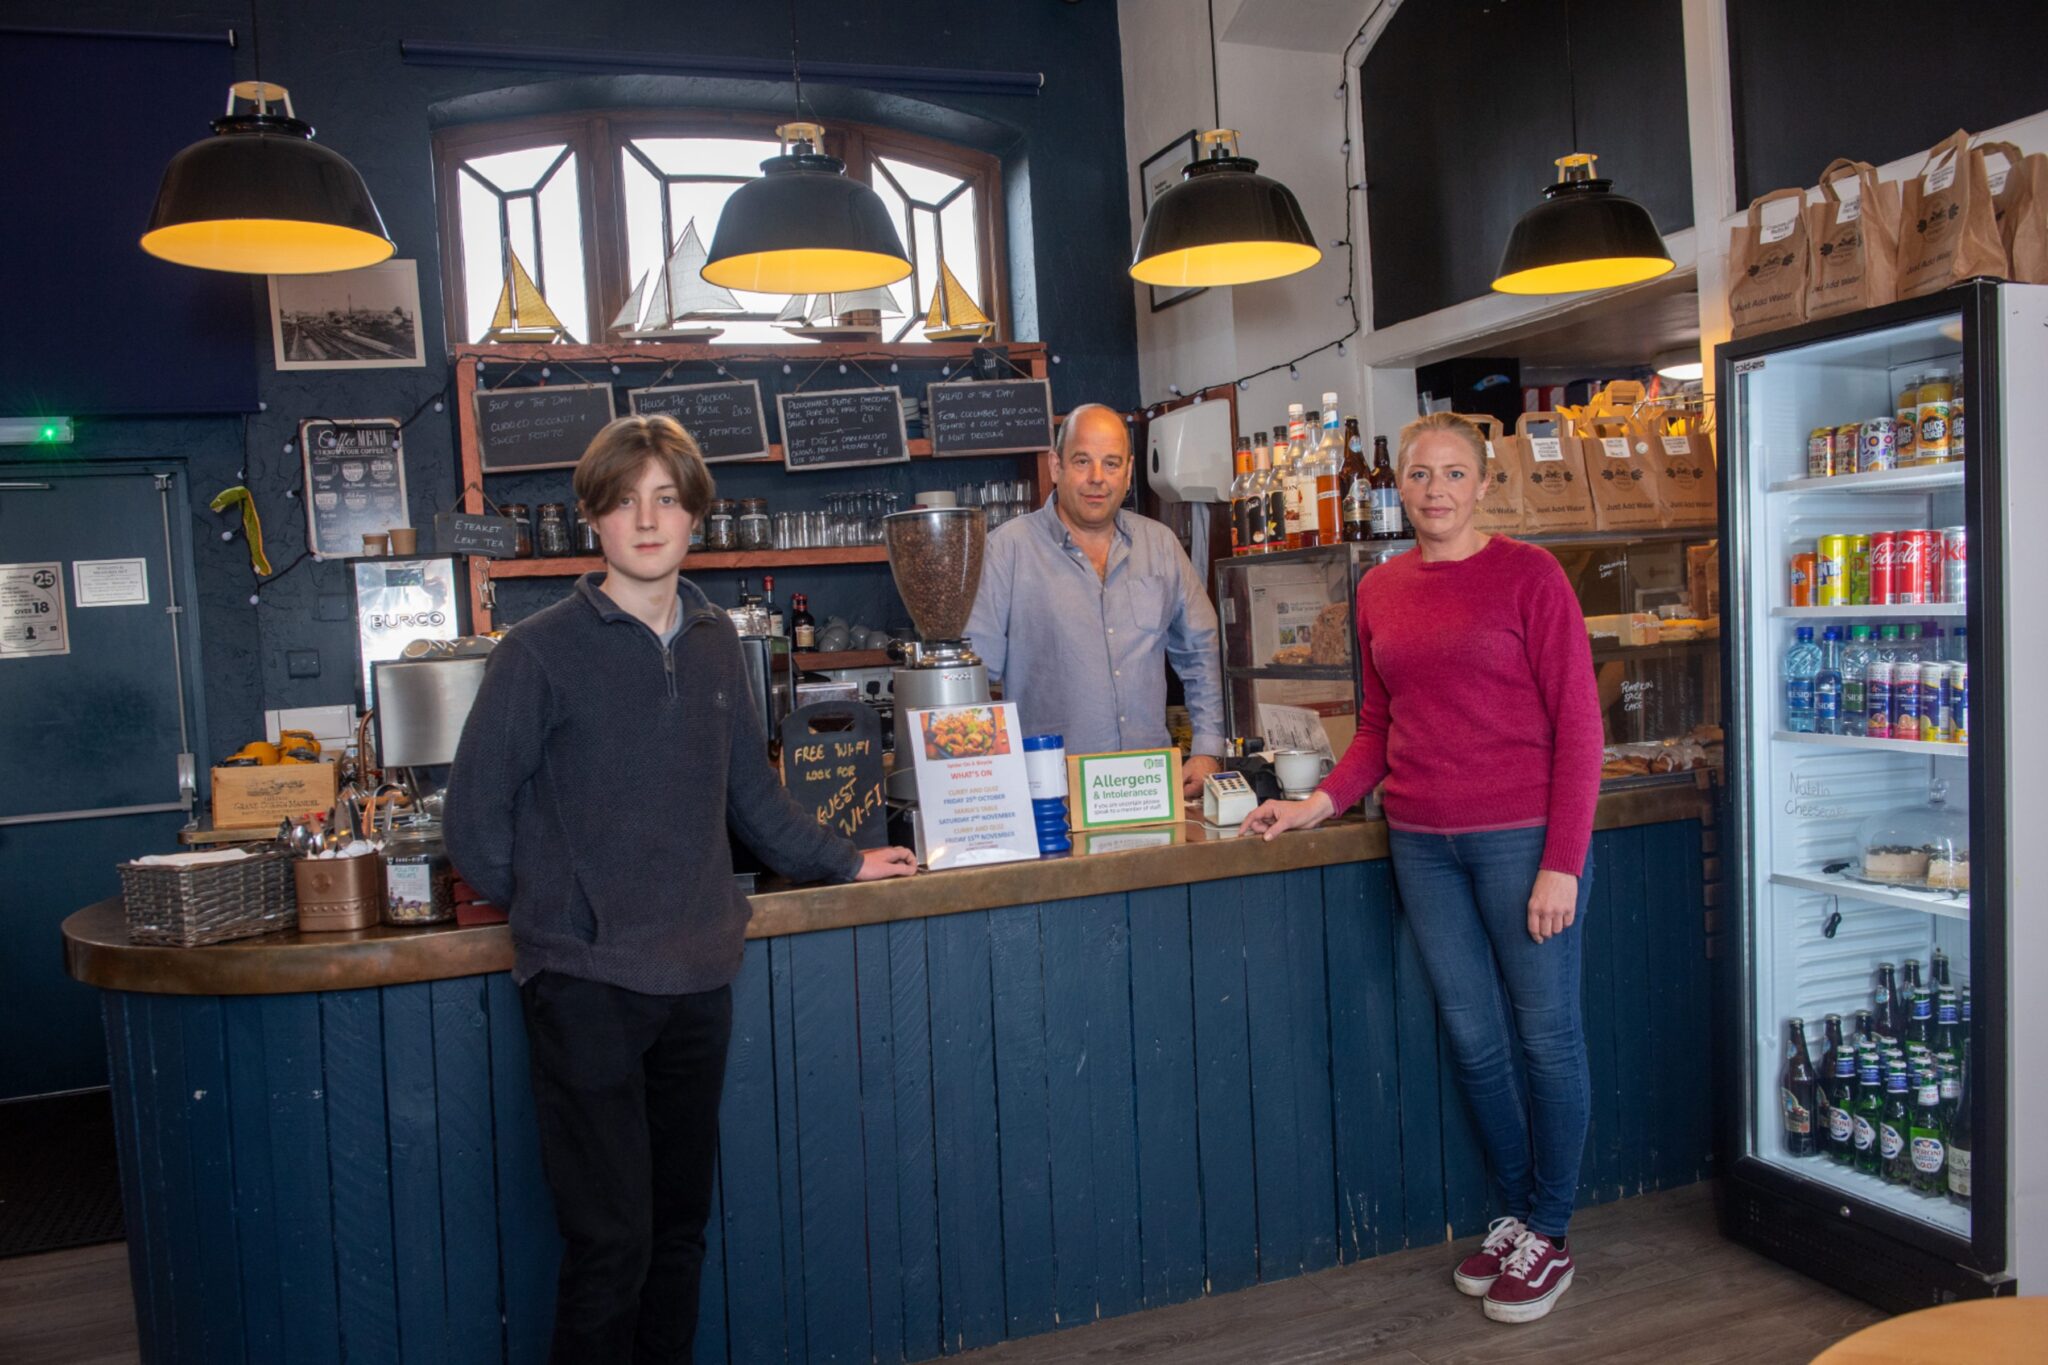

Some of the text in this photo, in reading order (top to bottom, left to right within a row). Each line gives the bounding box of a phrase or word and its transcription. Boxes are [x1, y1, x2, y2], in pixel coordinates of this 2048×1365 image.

[1768, 290, 1793, 304] Water
[1921, 419, 1945, 434] JUICE
[358, 429, 387, 447] MENU
[454, 519, 503, 534] ETEAKET
[454, 534, 504, 548] LEAF TEA
[34, 572, 55, 586] 25
[14, 601, 50, 616] OVER 18
[370, 611, 446, 630] BURCO
[794, 739, 870, 767] FREE WI-FI
[805, 764, 857, 782] LOOK FOR
[950, 769, 993, 781] WHAT'S ON
[1093, 773, 1162, 788] Allergens
[970, 786, 983, 795] AND
[1093, 788, 1159, 800] & Intolerances
[943, 796, 965, 806] FRIDAY
[977, 793, 1006, 802] OCTOBER
[938, 815, 971, 826] SATURDAY
[981, 811, 1016, 822] NOVEMBER
[975, 824, 989, 834] AND
[944, 835, 967, 845] FRIDAY
[981, 830, 1016, 841] NOVEMBER
[1912, 1146, 1942, 1157] PERONI
